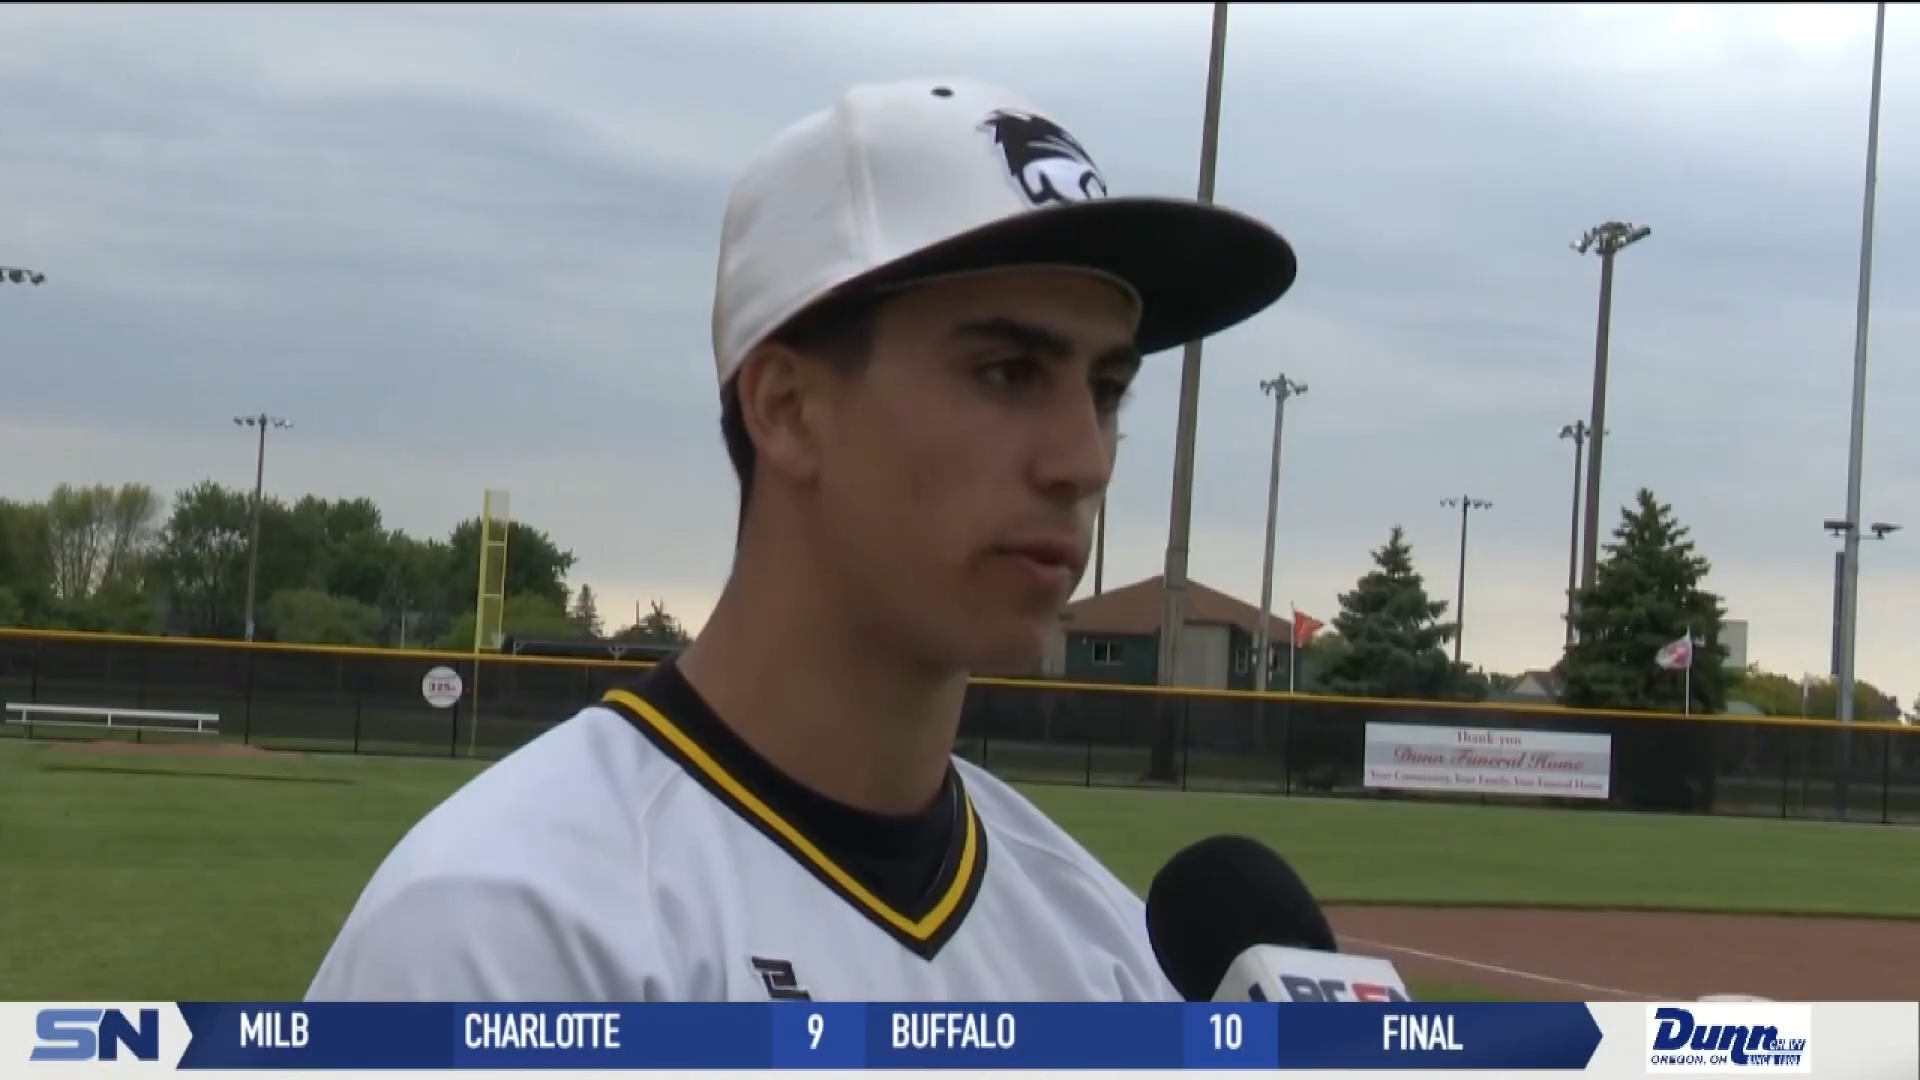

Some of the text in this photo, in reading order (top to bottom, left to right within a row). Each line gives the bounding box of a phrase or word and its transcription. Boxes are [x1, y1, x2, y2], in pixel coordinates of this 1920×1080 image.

[1394, 746, 1585, 770] Dunn Funeral Home
